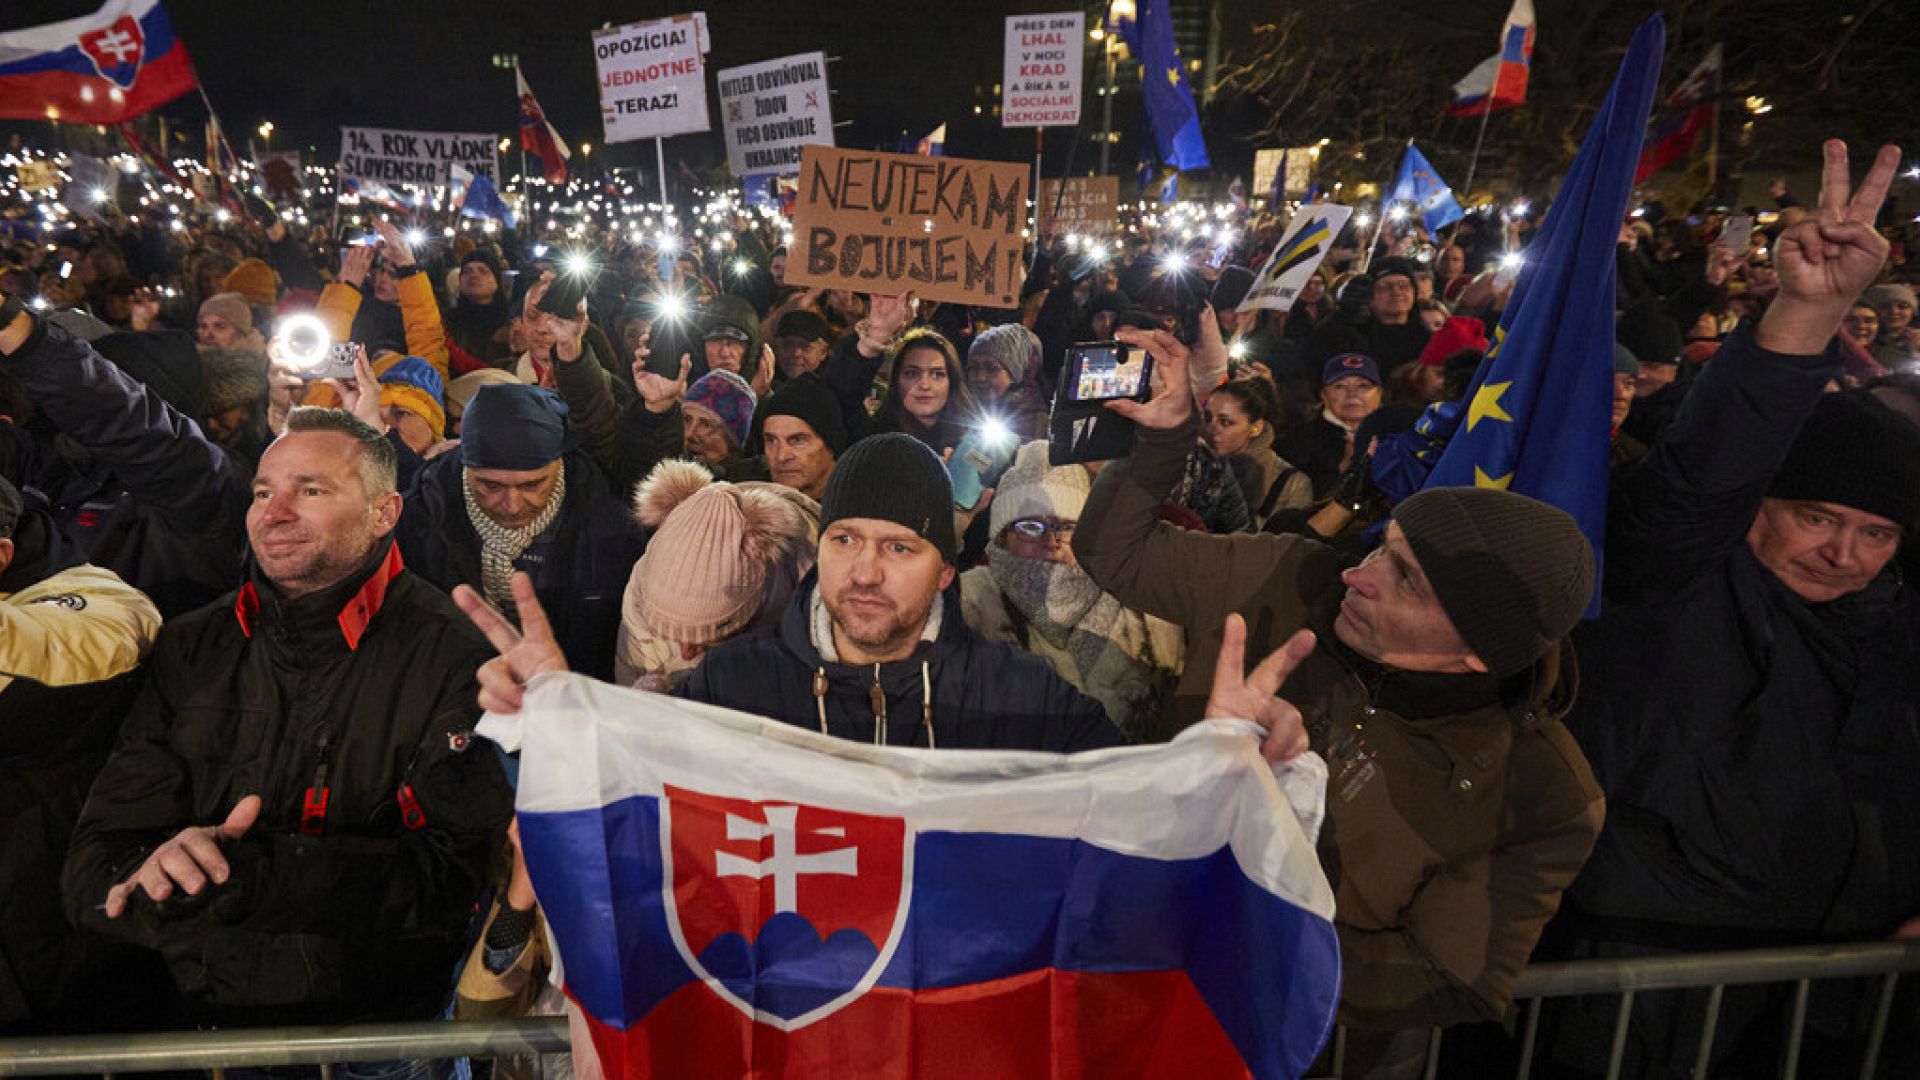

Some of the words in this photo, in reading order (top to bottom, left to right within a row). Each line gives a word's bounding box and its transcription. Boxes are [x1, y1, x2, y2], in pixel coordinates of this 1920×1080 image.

[1050, 19, 1075, 29] DEN
[598, 29, 687, 59] OPOZÍCIA!
[1021, 32, 1066, 48] LHAL
[1022, 52, 1031, 61] V
[1035, 51, 1065, 60] NOCI
[601, 58, 697, 88] JEDNOTNE
[1019, 64, 1066, 77] KRAD
[1011, 82, 1020, 91] A
[615, 93, 678, 119] TERAZ!
[1005, 110, 1077, 123] DEMOKRAT
[382, 133, 418, 157] ROK
[745, 144, 804, 170] UKRAJINCO
[807, 226, 1018, 304] BOJUJEM!
